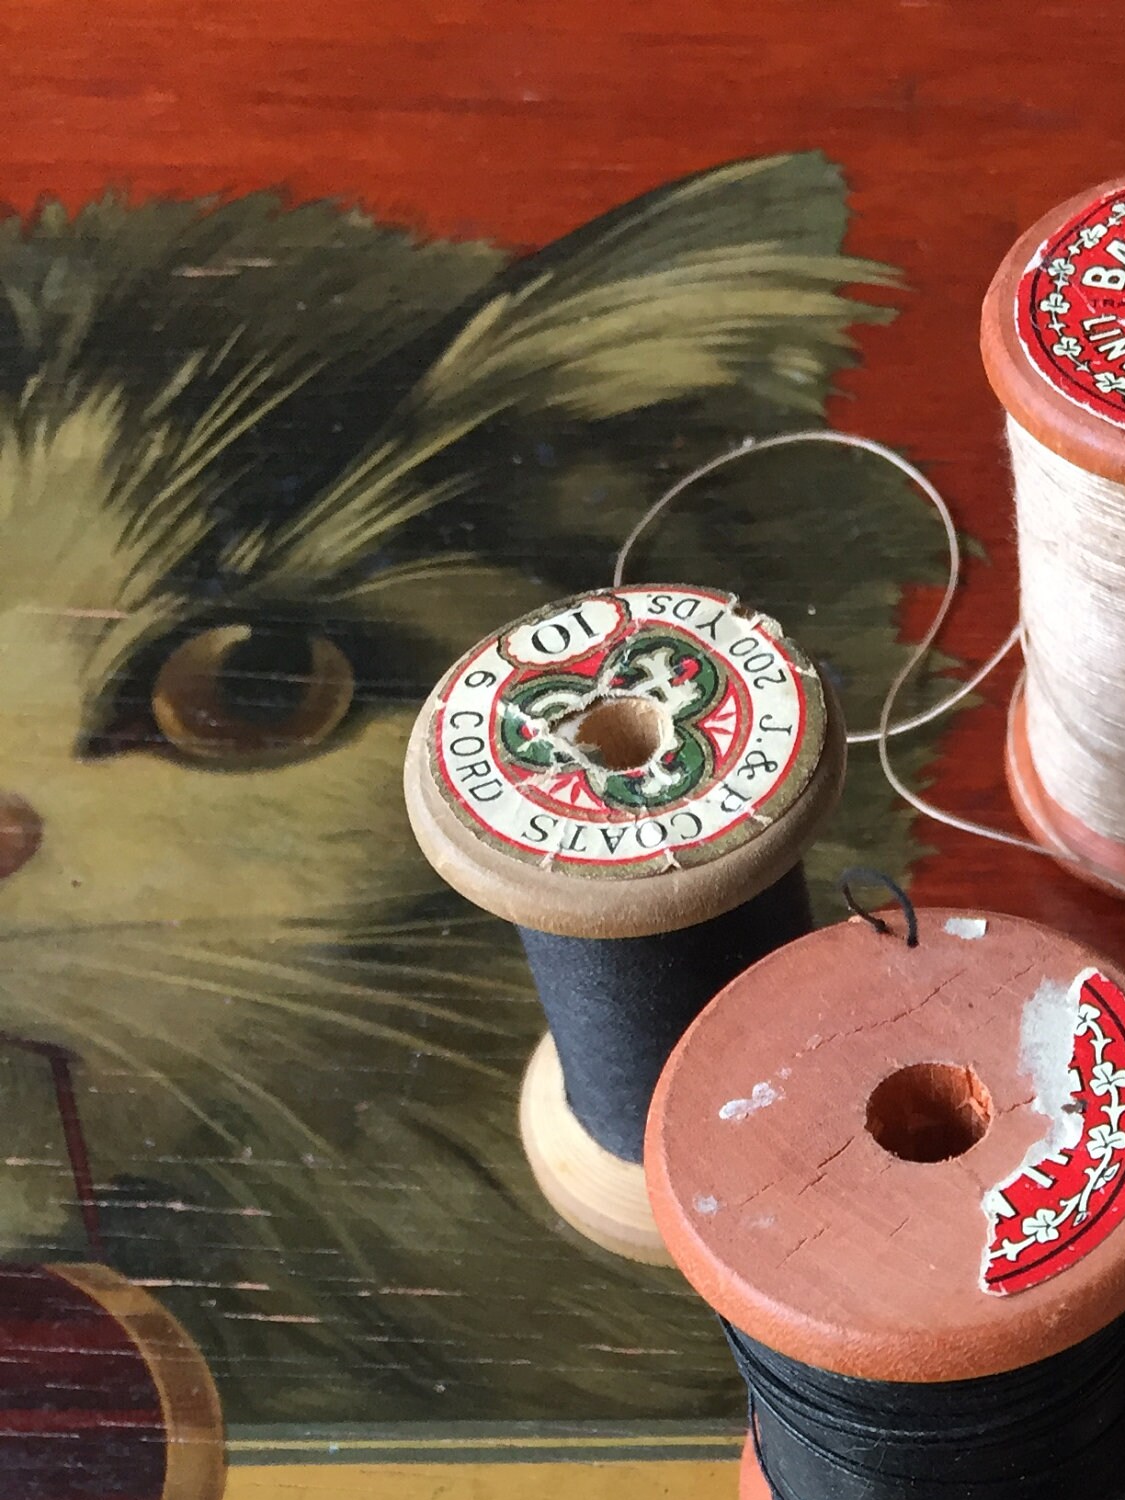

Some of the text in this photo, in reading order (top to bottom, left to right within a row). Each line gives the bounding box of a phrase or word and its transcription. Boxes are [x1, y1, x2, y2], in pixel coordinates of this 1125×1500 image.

[729, 635, 788, 690] 200
[448, 668, 505, 803] 6 CORD
[521, 810, 703, 855] COATS
